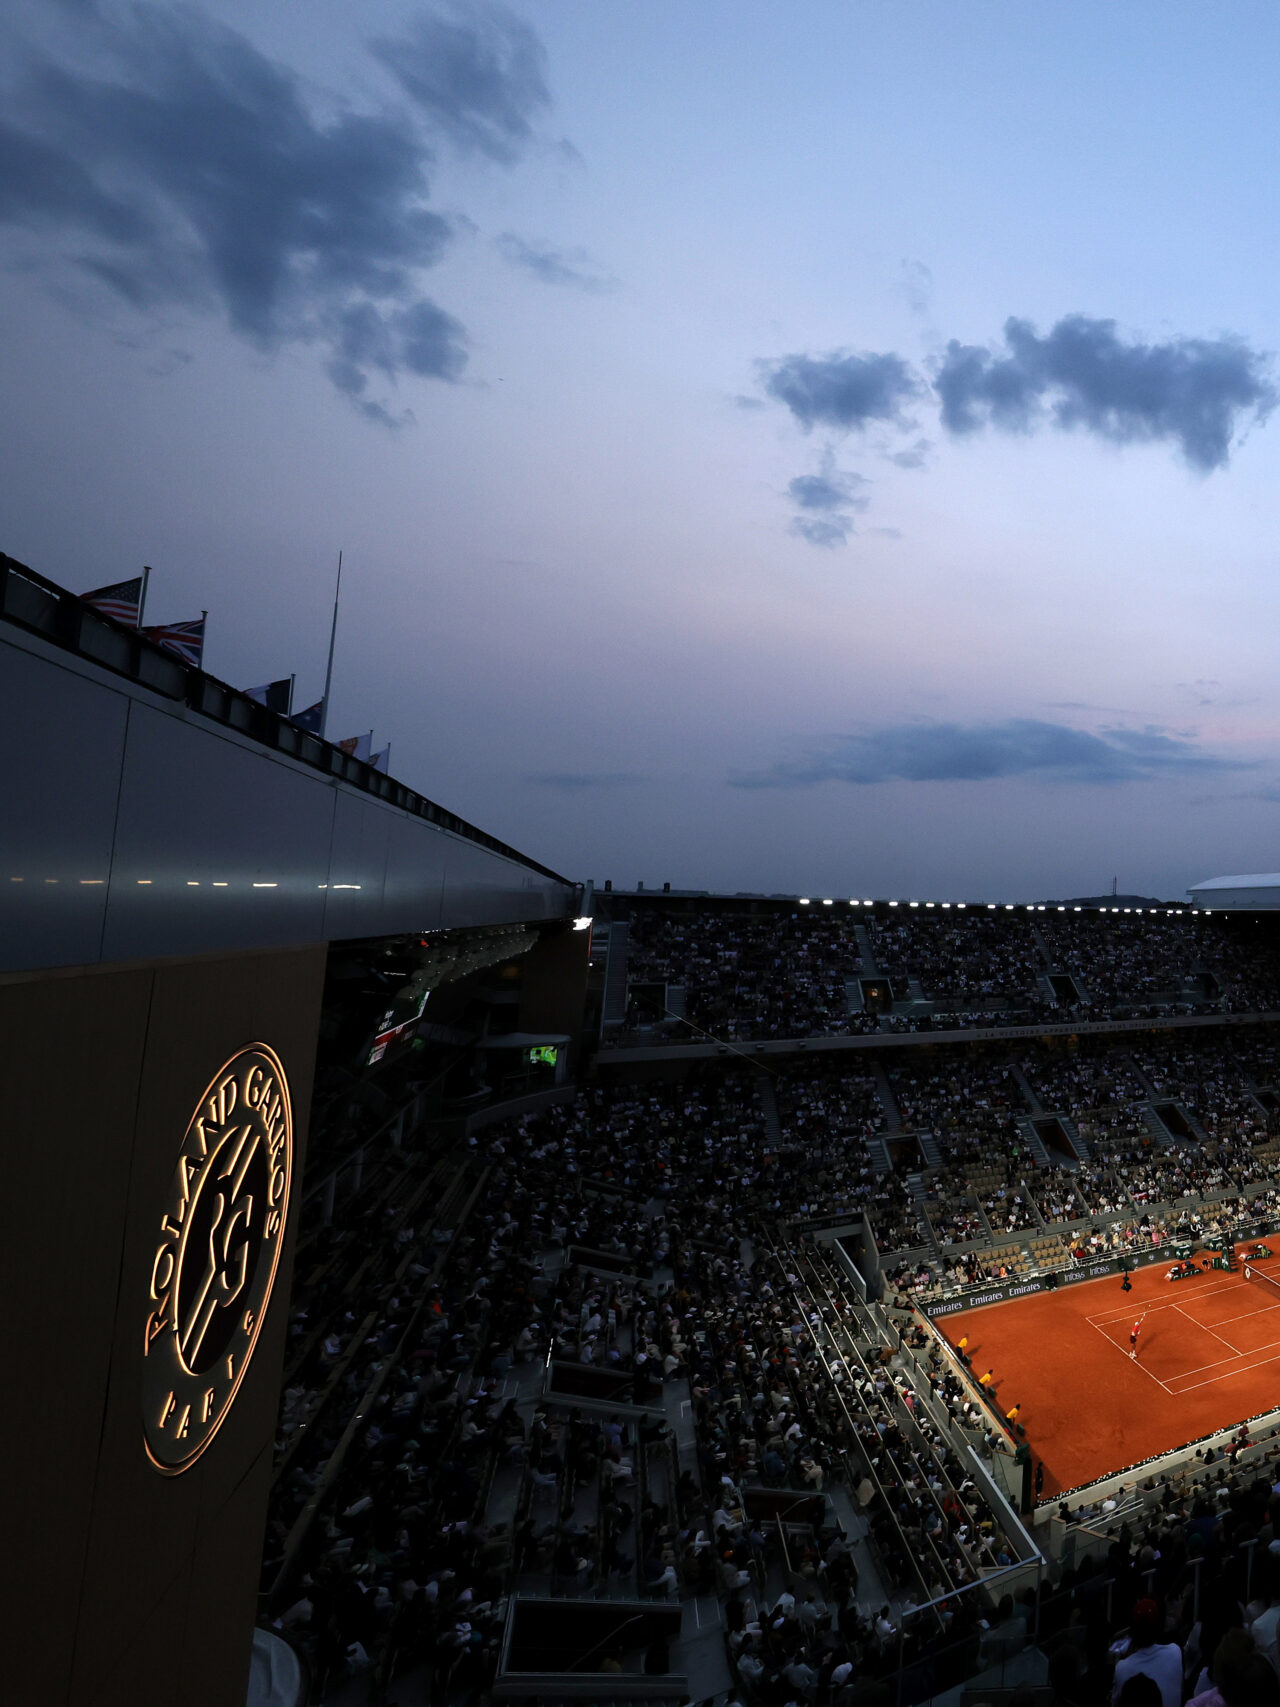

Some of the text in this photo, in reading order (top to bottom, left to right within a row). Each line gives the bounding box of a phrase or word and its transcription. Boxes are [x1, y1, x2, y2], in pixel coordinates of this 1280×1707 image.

[144, 1065, 286, 1357] ROLAND GARROS
[1008, 1282, 1041, 1297] Emirates
[969, 1290, 1003, 1307] Emirates
[927, 1301, 963, 1317] Emirates
[157, 1309, 254, 1440] PARIS
